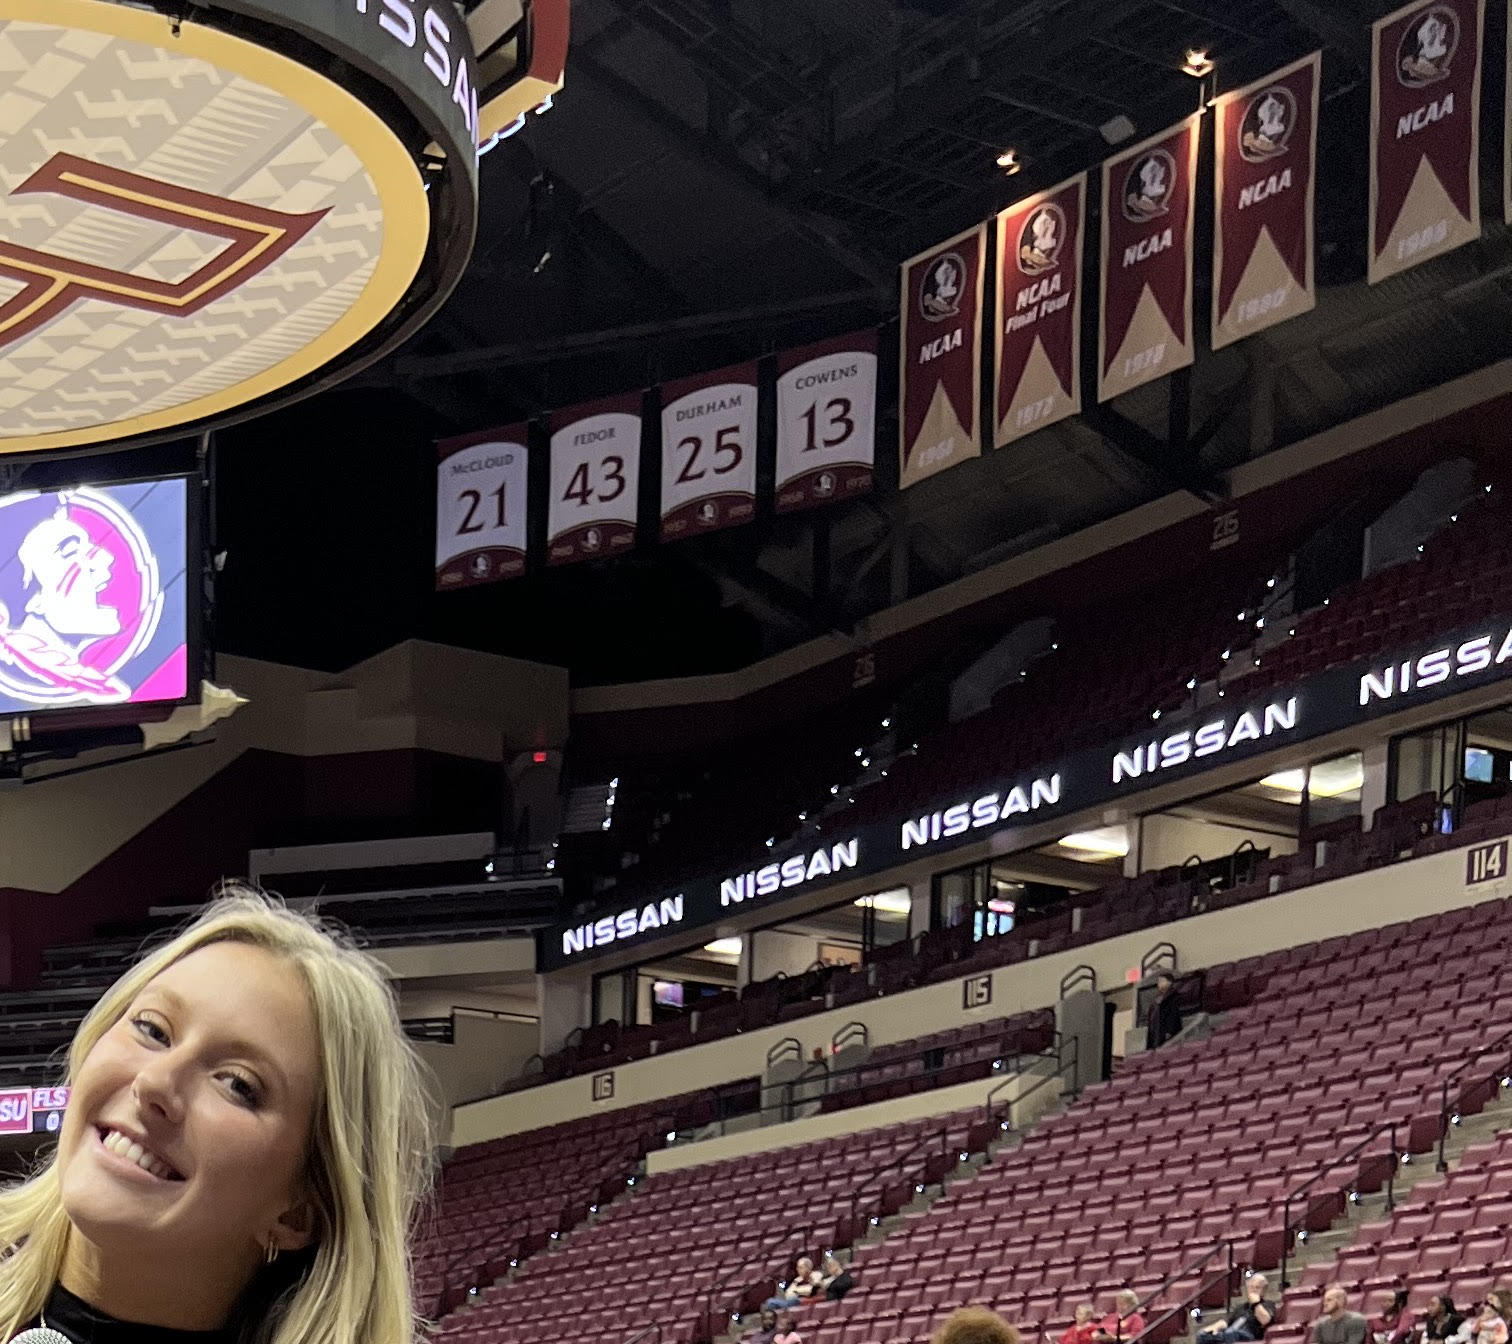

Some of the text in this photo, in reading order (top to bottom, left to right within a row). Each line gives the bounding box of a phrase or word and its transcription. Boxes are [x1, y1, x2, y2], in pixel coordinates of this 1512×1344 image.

[1396, 92, 1455, 139] NCAA
[1238, 168, 1293, 210] NCAA
[1122, 228, 1173, 267] NCAA
[1016, 272, 1062, 311] NCAA
[919, 329, 963, 364] NCAA
[795, 364, 858, 391] COWENS
[676, 395, 742, 423] DURHAM
[798, 397, 855, 454] 13
[574, 428, 617, 447] FEDOR
[673, 424, 743, 486] 25
[451, 454, 514, 475] McCLOUD
[562, 455, 627, 508] 43
[455, 480, 509, 537] 21
[1113, 697, 1297, 783] NISSAN
[902, 774, 1061, 849] NISSAN
[721, 839, 857, 906] NISSAN
[1473, 845, 1502, 882] 114
[563, 894, 684, 954] NISSAN
[46, 1111, 60, 1131] 0
